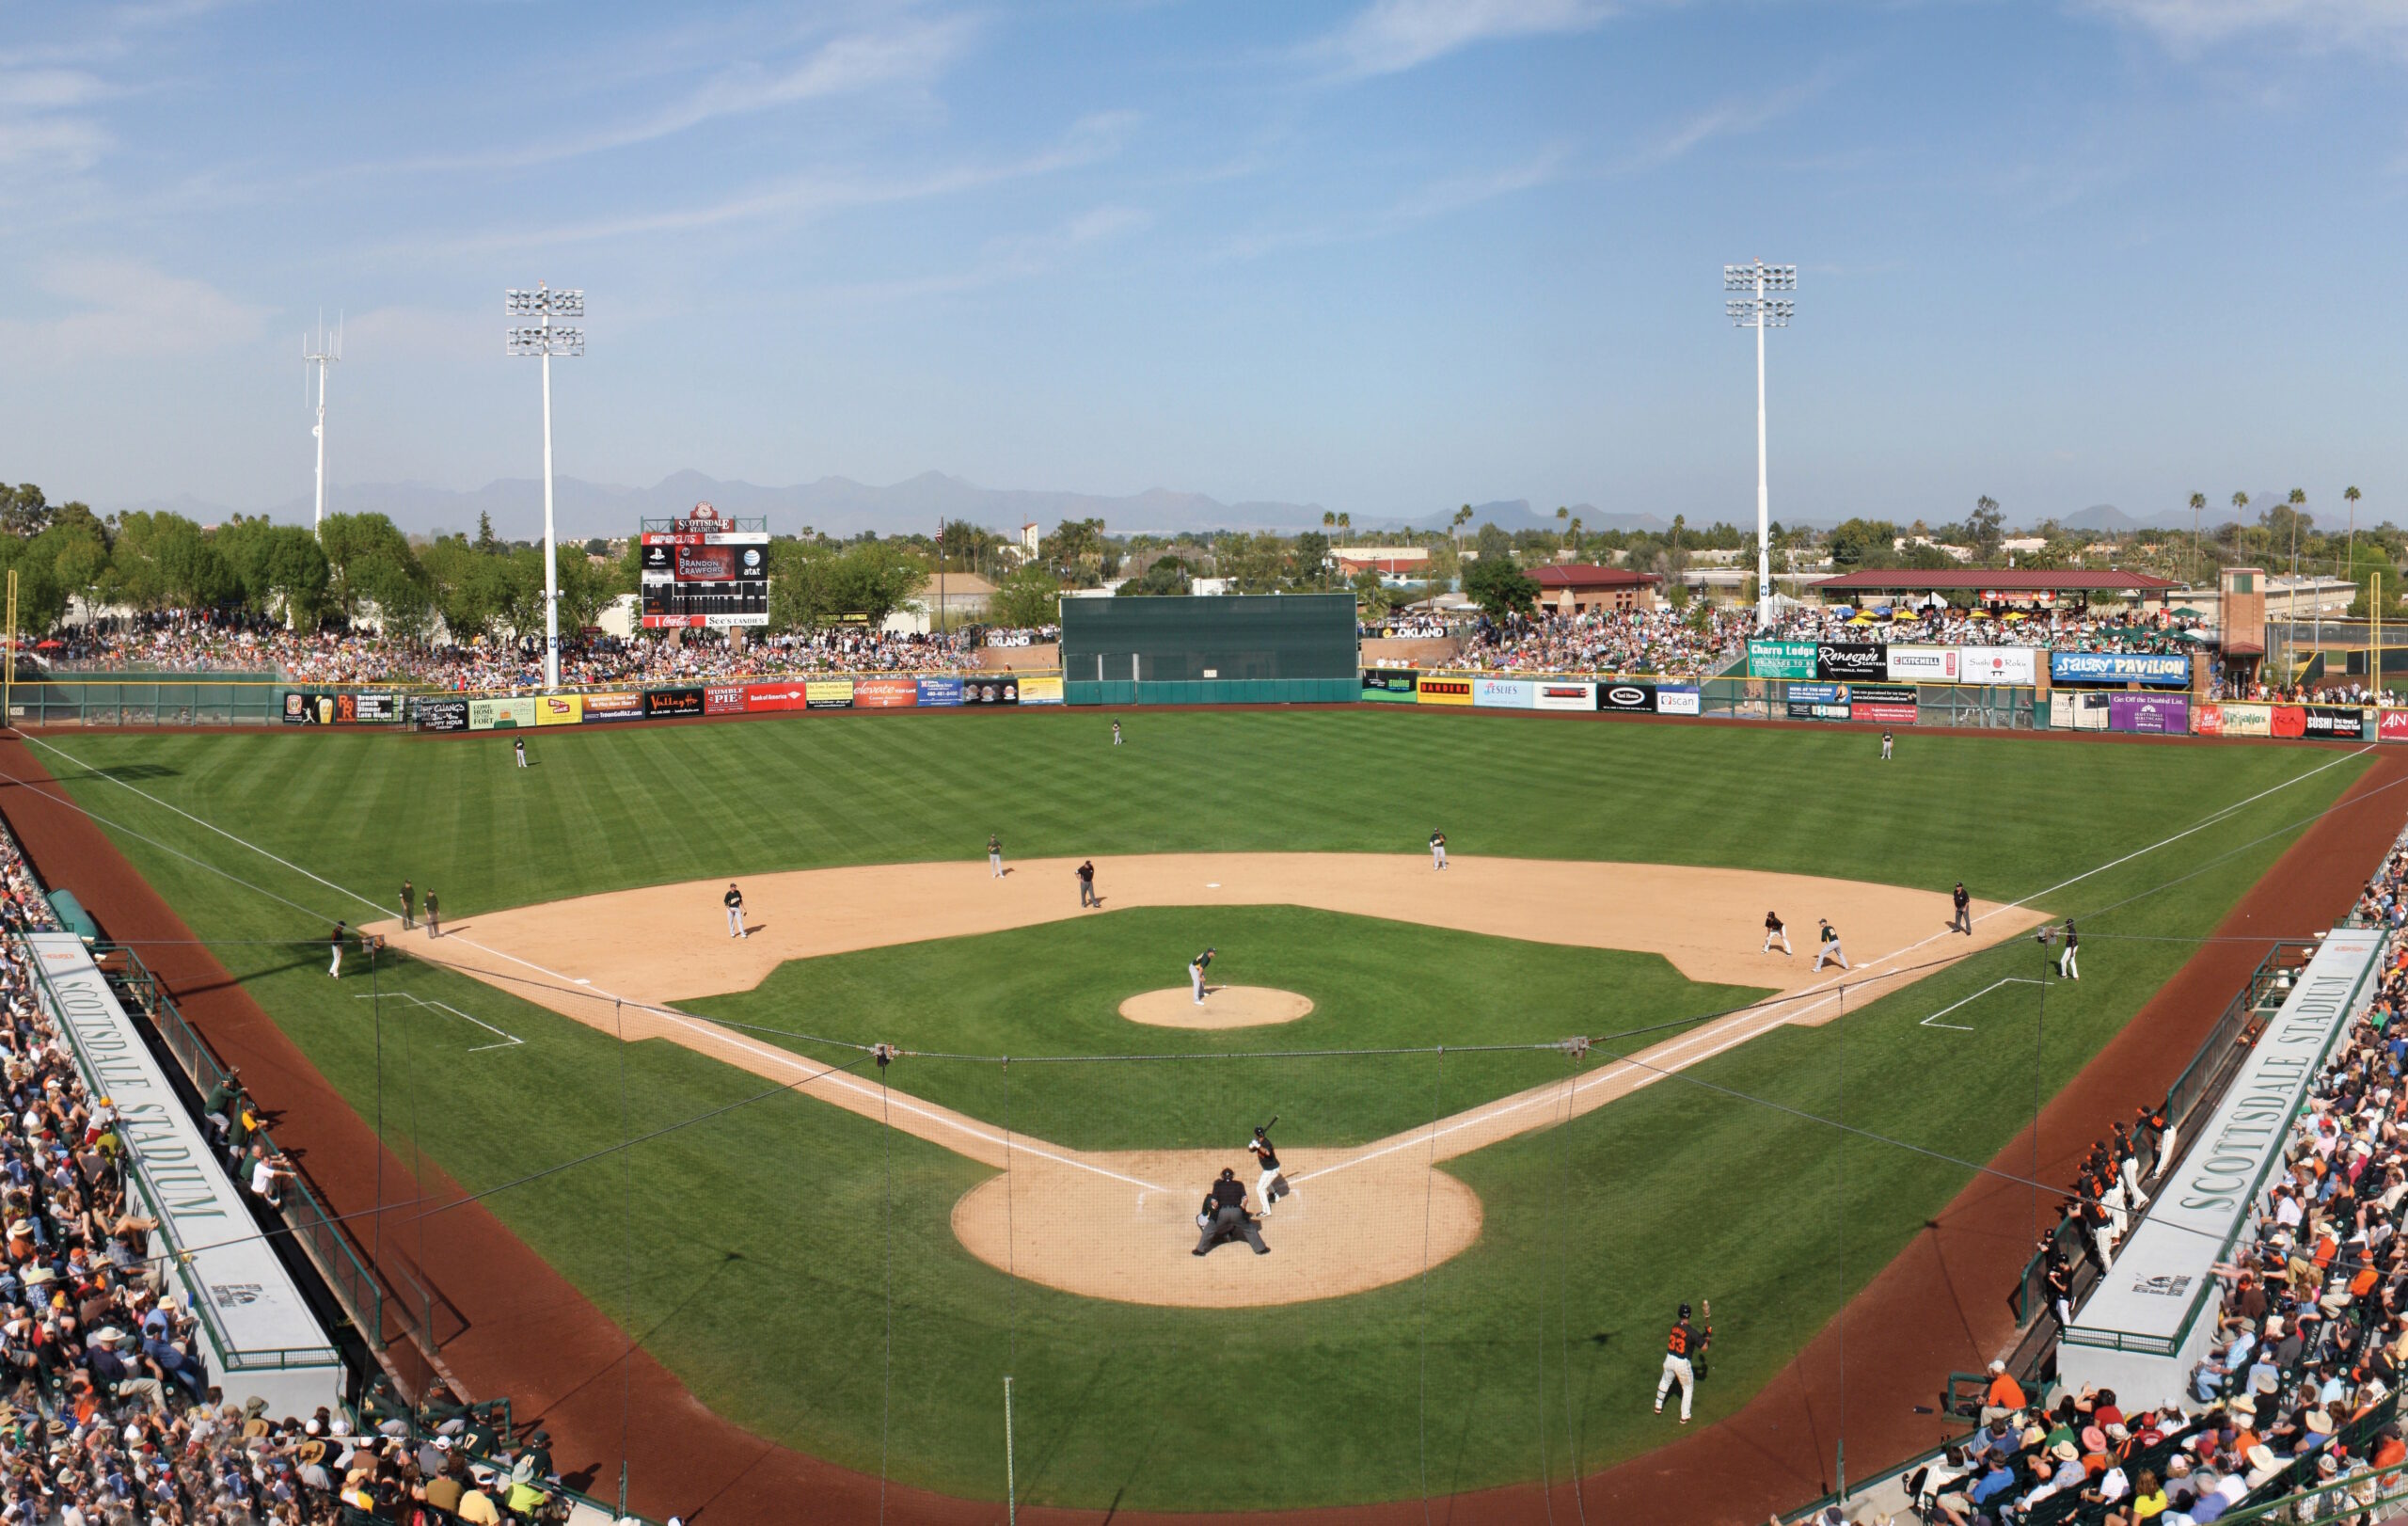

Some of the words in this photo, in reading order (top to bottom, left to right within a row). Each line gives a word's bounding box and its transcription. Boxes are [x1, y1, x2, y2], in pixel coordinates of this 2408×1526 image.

[679, 518, 730, 530] SCOTTSDALE
[649, 535, 696, 544] SUPERCUTS
[679, 558, 719, 566] BRANDON
[679, 566, 723, 575] CRAWFORD
[743, 567, 761, 576] at&t
[708, 616, 732, 625] See's
[1751, 644, 1782, 656] Charro
[1786, 645, 1815, 657] Lodge
[1818, 646, 1878, 667] Renegade
[1901, 657, 1940, 666] KITCHELL
[1969, 658, 1991, 667] Sushi
[2004, 659, 2027, 667] Roku
[2115, 659, 2185, 676] PAVILION
[707, 687, 744, 695] HUMBLE
[853, 681, 895, 694] elevate
[1421, 683, 1468, 692] BANDERA
[1485, 684, 1518, 695] LESLIE'S
[650, 693, 685, 709] Valley
[685, 693, 699, 707] Ho
[714, 693, 738, 704] PIE
[1671, 697, 1694, 707] scan
[434, 703, 466, 713] CHANG'S
[599, 710, 642, 719] TroonGolfAZ.com
[2306, 717, 2333, 729] SUSHI
[2278, 976, 2353, 1044] STADIUM
[55, 980, 151, 1090] SCOTTSDALE
[2179, 1056, 2310, 1212] SCOTTSDALE
[119, 1103, 228, 1219] STADIUM
[1668, 1333, 1687, 1354] 33
